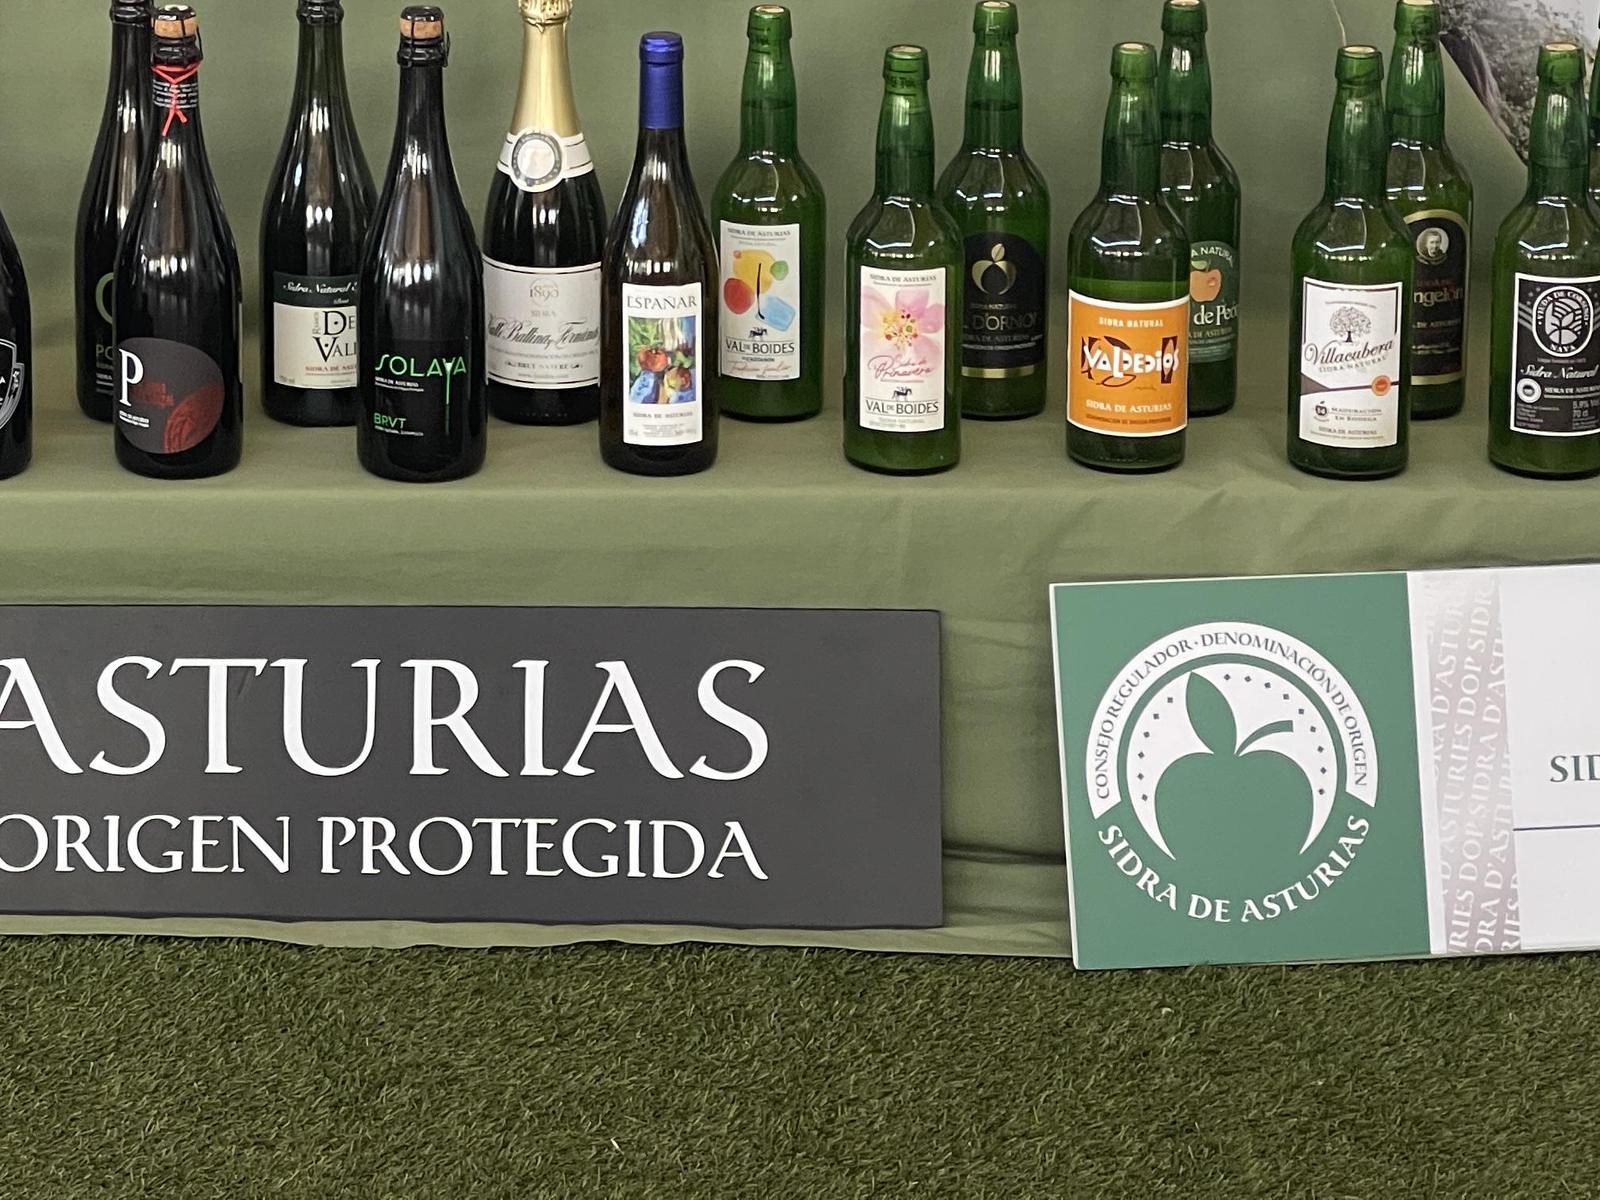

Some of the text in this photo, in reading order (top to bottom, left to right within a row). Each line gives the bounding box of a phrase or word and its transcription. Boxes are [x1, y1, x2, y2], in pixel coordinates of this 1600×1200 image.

[627, 294, 698, 312] ESPAÑAR
[1099, 317, 1122, 327] SIDRA
[725, 341, 744, 353] VAL
[752, 340, 795, 354] BOIDES
[119, 348, 144, 407] P
[866, 401, 887, 413] VAL
[896, 400, 940, 415] BOIDES
[1086, 399, 1172, 413] SIDRA DE ASTURIAS
[1094, 630, 1368, 801] CONSEJO REGULADOR DENOMINACIÓN DE ORIGEN
[1549, 753, 1600, 784] SID
[317, 813, 770, 881] PROTEGIDA
[1098, 812, 1371, 923] SIDRA DE ASTURIAS
